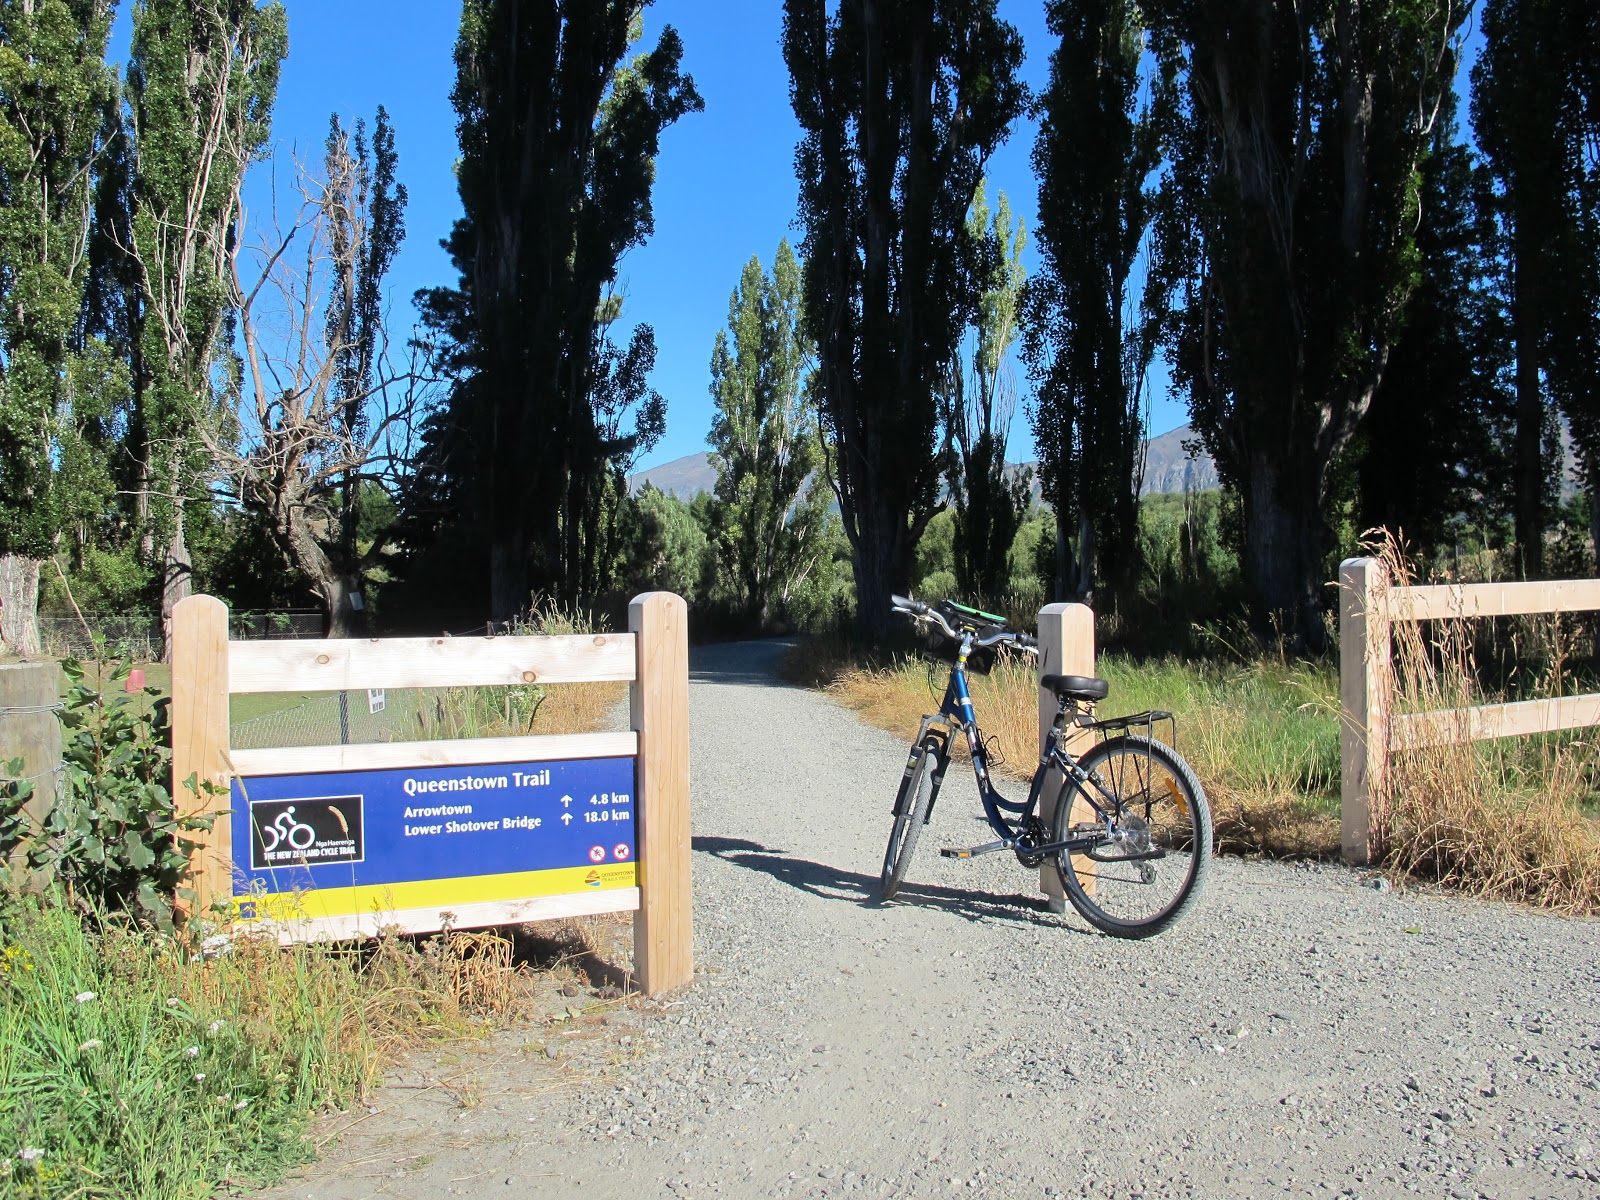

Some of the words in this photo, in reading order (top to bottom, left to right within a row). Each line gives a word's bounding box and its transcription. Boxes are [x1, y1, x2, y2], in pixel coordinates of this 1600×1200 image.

[403, 774, 508, 796] Queenstown
[512, 770, 550, 787] Trail
[590, 793, 609, 806] 4.8
[611, 792, 630, 804] km
[403, 804, 473, 818] Arrowtown
[583, 811, 609, 823] 18.0
[611, 809, 630, 821] km
[404, 824, 443, 837] Lower
[445, 820, 500, 834] Shotover
[502, 816, 542, 830] Bridge
[264, 852, 277, 860] THE
[277, 851, 292, 859] NEW
[320, 847, 339, 855] CYCLE
[339, 846, 356, 854] TRAIL
